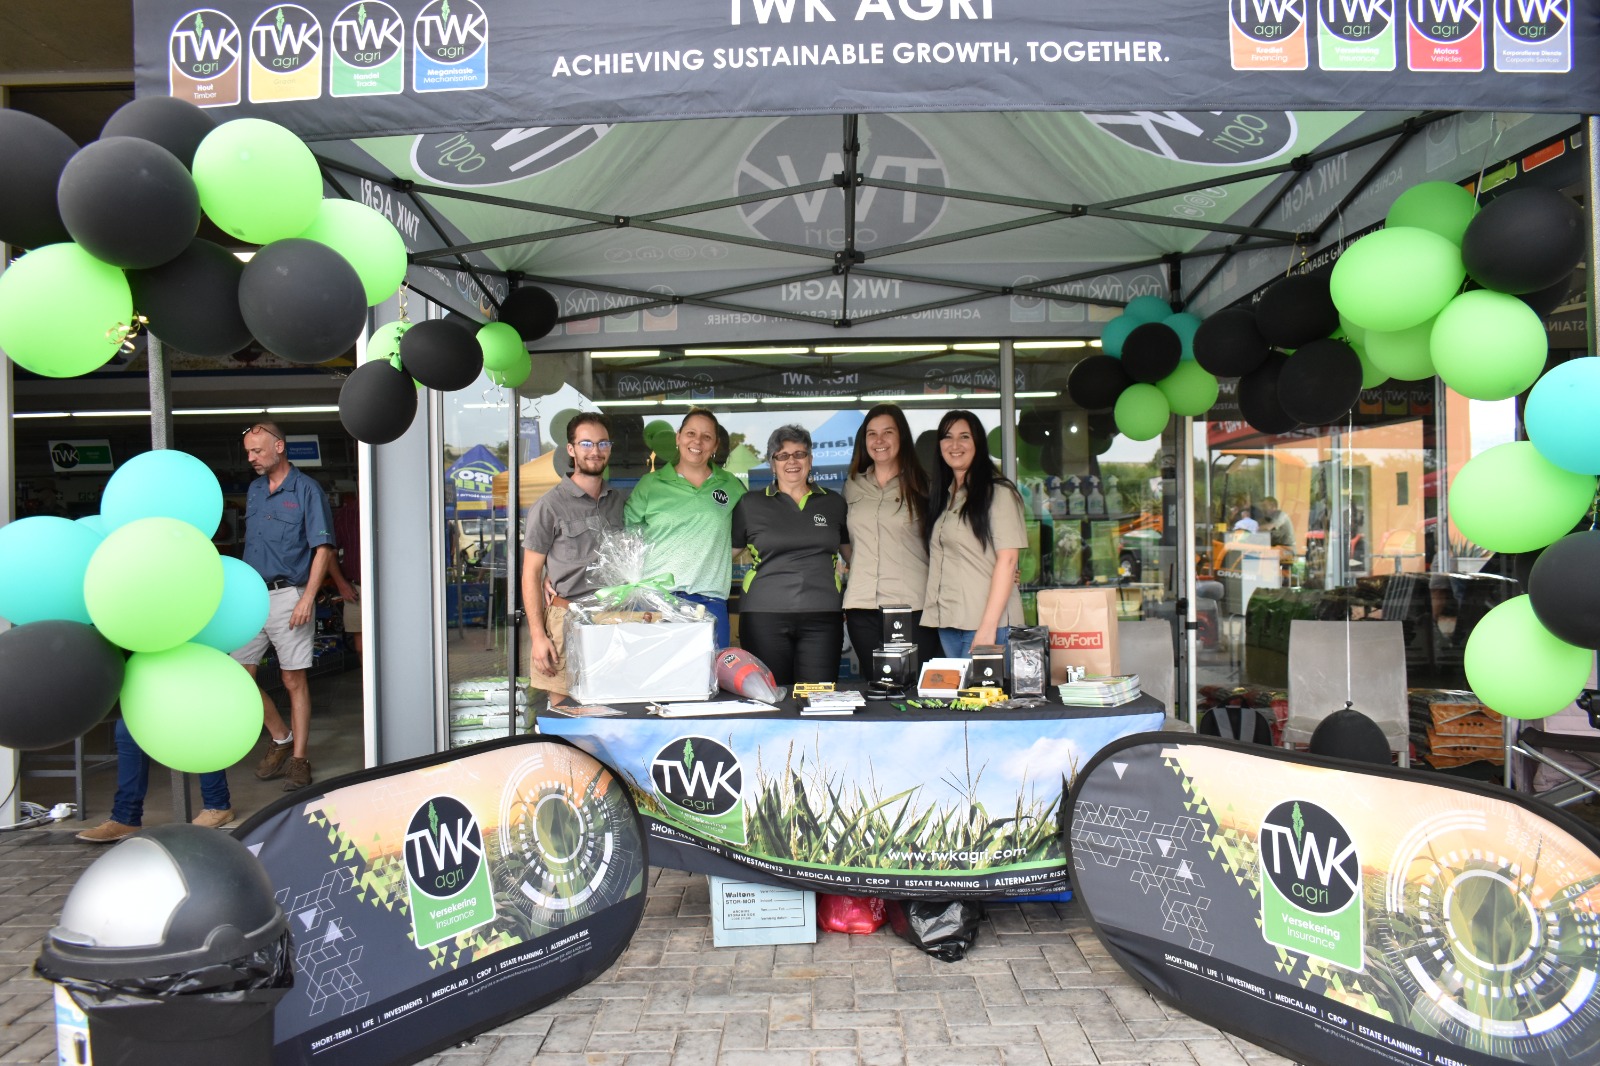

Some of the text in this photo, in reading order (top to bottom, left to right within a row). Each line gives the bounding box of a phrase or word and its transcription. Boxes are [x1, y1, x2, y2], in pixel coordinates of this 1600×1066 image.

[335, 18, 402, 51] TWK
[418, 13, 485, 46] TWK
[1254, 24, 1282, 38] agri
[1343, 24, 1370, 37] agri
[1431, 24, 1459, 38] agri
[1518, 25, 1546, 38] agri
[172, 28, 239, 62] TWK
[253, 23, 319, 57] TWK
[354, 51, 381, 63] agri
[438, 45, 465, 58] agri
[552, 41, 1170, 77] ACHIEVING SUSTAINABLE GROWTH, TOGETHER.
[1251, 54, 1288, 63] Financing
[1431, 55, 1462, 63] Vehicles
[1433, 47, 1459, 55] Motors
[193, 61, 219, 74] agri
[273, 55, 299, 68] agri
[354, 72, 379, 80] Handel
[424, 75, 478, 84] Mechanisation
[427, 68, 473, 76] Meganisasie
[52, 450, 79, 462] TWK
[713, 491, 729, 502] TWK
[1049, 634, 1100, 648] MayFord
[653, 760, 741, 799] TWK
[682, 799, 715, 811] agri
[405, 817, 481, 878] TWK
[887, 846, 1028, 864] www.twkagri.com
[1261, 822, 1357, 893] TWK
[707, 845, 721, 854] LIFE
[732, 853, 783, 872] INVESTMENTS
[797, 870, 834, 881] MEDICAL
[935, 880, 980, 888] PLANNING
[994, 873, 1047, 887] ALTERNATIVE
[1050, 870, 1066, 878] RISK
[435, 866, 464, 889] agri
[1292, 882, 1329, 905] agri
[430, 897, 477, 920] Versekering
[436, 908, 475, 929] Insurance
[1282, 912, 1340, 940] Versekering
[1287, 926, 1335, 949] Insurance
[311, 929, 589, 1050] SHORT-TERM LIFE INVESTMENTS MEDICAL AID CROP ESTATE PLANNING ALTERNATIVE RISK
[1165, 953, 1468, 1066] SHORT-TERM LIFE INVESTMENTS MEDICAL AID CROP ESTATE PLANNING ALTERN
